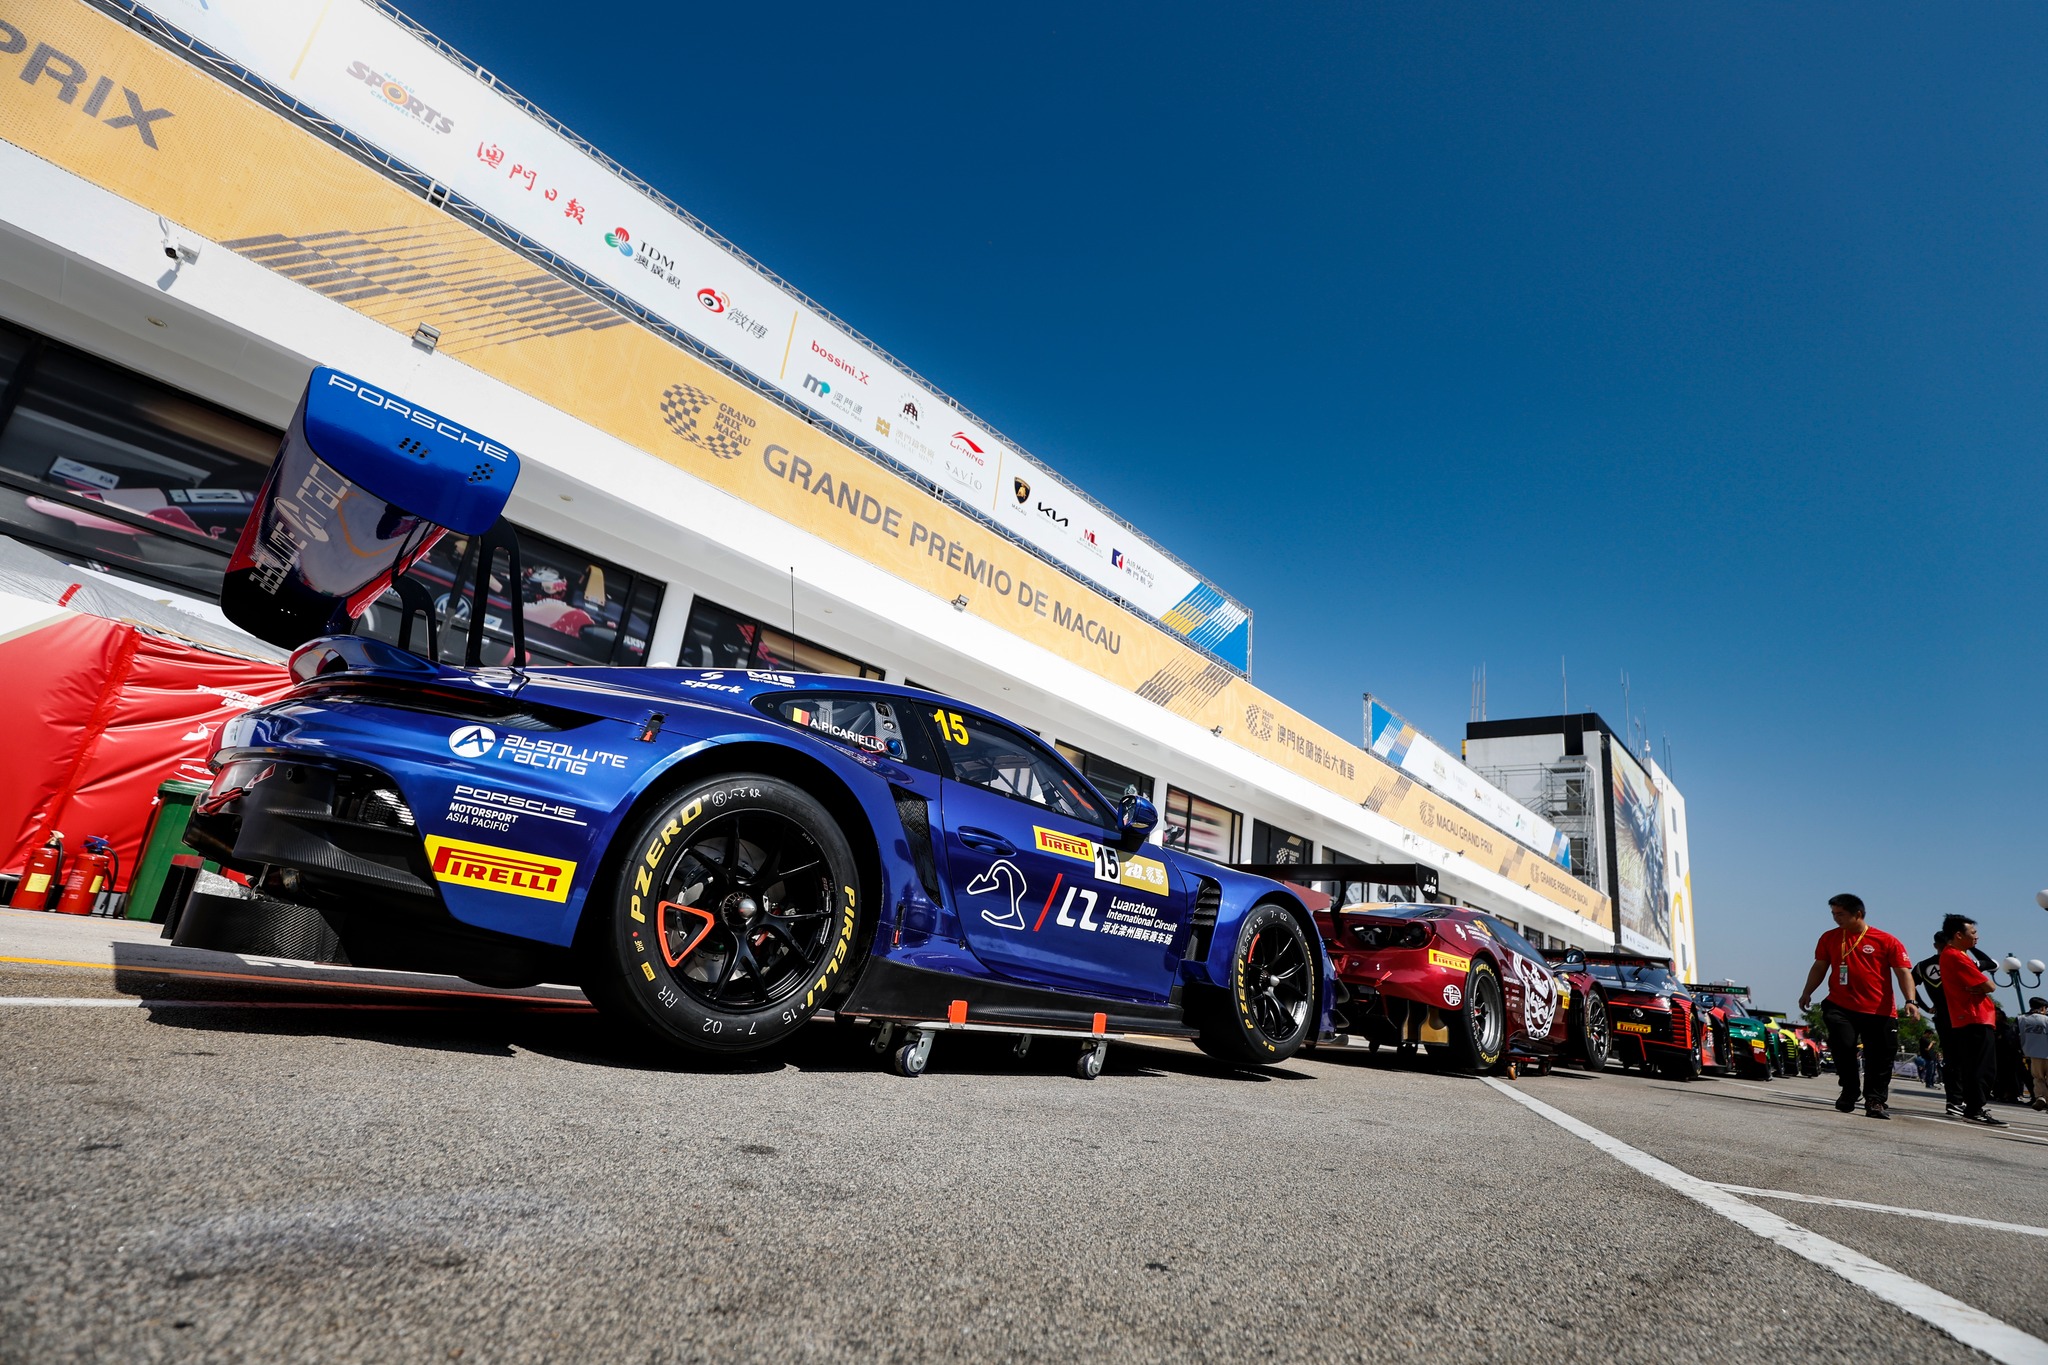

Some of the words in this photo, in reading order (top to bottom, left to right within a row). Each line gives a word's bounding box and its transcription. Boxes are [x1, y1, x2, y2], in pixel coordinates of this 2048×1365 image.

[346, 60, 455, 135] SPORTS
[384, 72, 415, 95] MACAU
[370, 89, 411, 119] CHANNEL
[477, 141, 586, 225] 澳門日報
[634, 252, 682, 290] 澳廣視
[639, 240, 676, 271] TDM
[727, 308, 769, 340] 微博
[811, 340, 870, 386] bossini.X
[328, 374, 509, 462] PORSCHE
[715, 412, 738, 432] PRIX
[718, 402, 756, 428] GRAND
[712, 422, 751, 447] MACAU
[950, 440, 984, 466] LI-NING
[763, 444, 902, 538] GRANDE
[909, 521, 1012, 596] PRÉMIO
[1018, 580, 1049, 617] DE
[1053, 600, 1121, 655] MACAU
[933, 708, 970, 746] 15
[449, 802, 519, 824] MOTORSPORT
[455, 785, 577, 819] PORSCHE
[446, 812, 470, 826] ASIA
[470, 817, 511, 832] PACIFIC
[1436, 813, 1459, 835] MACAU
[1459, 823, 1480, 848] GRAND
[1480, 837, 1494, 856] PRIX
[1041, 831, 1090, 857] PIRELLI
[432, 845, 562, 893] PIRELLI
[1096, 847, 1119, 880] 15
[1106, 909, 1154, 927] International
[1154, 919, 1178, 932] Circuit
[1110, 896, 1157, 917] Luanzhou
[807, 885, 855, 1008] PIRELLI
[1101, 921, 1172, 945] 河北滦州国际赛车场
[657, 985, 679, 1009] RR
